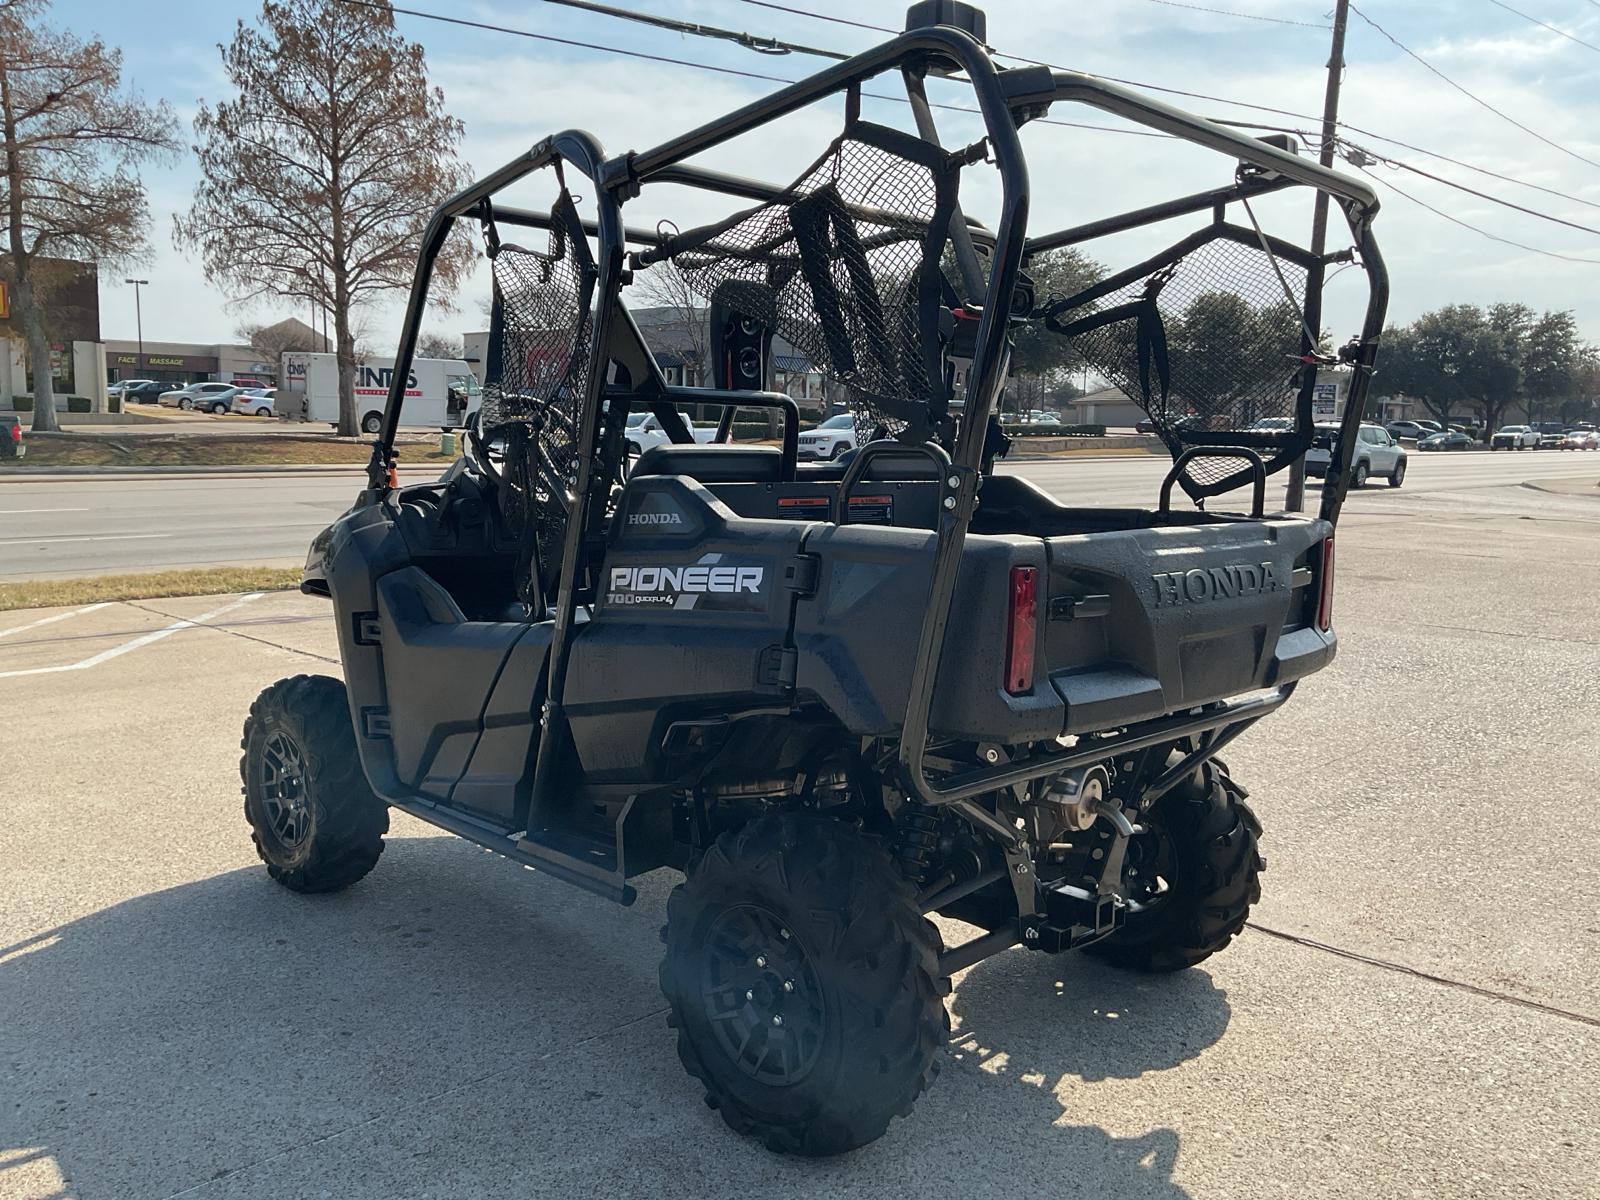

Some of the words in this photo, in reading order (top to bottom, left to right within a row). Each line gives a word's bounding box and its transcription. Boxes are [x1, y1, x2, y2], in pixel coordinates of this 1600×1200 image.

[117, 356, 137, 364] FACE
[149, 357, 184, 366] MASSAGE
[628, 513, 682, 525] HONDA
[610, 566, 763, 593] PIONEER
[1152, 560, 1284, 608] HONDA
[606, 593, 635, 604] 700
